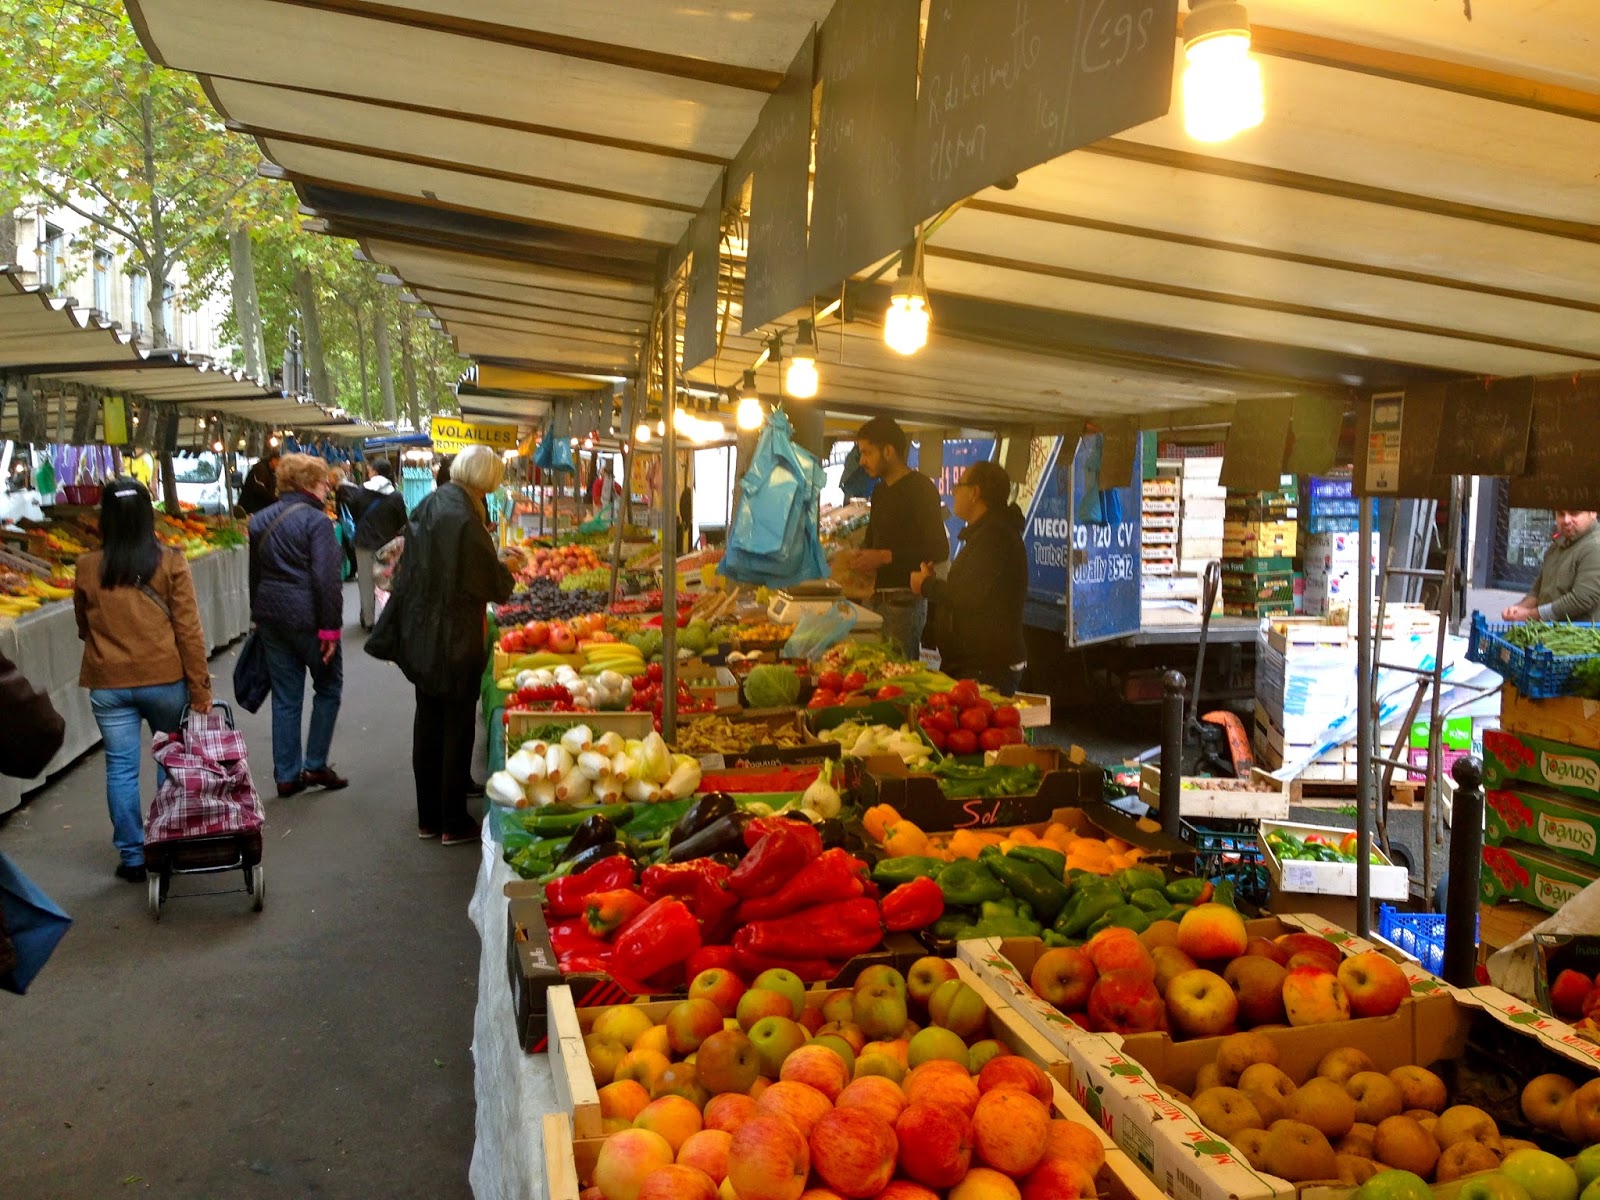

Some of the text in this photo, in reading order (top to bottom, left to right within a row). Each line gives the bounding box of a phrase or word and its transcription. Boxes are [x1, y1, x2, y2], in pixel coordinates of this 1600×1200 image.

[437, 424, 511, 442] VOLAILLES
[1033, 517, 1068, 538] IVECO
[1092, 523, 1112, 548] 120
[1117, 522, 1134, 548] CV
[1546, 758, 1597, 786] Savéol
[953, 800, 1001, 828] Sol
[1542, 819, 1593, 850] Savéol
[1539, 880, 1576, 904] véol
